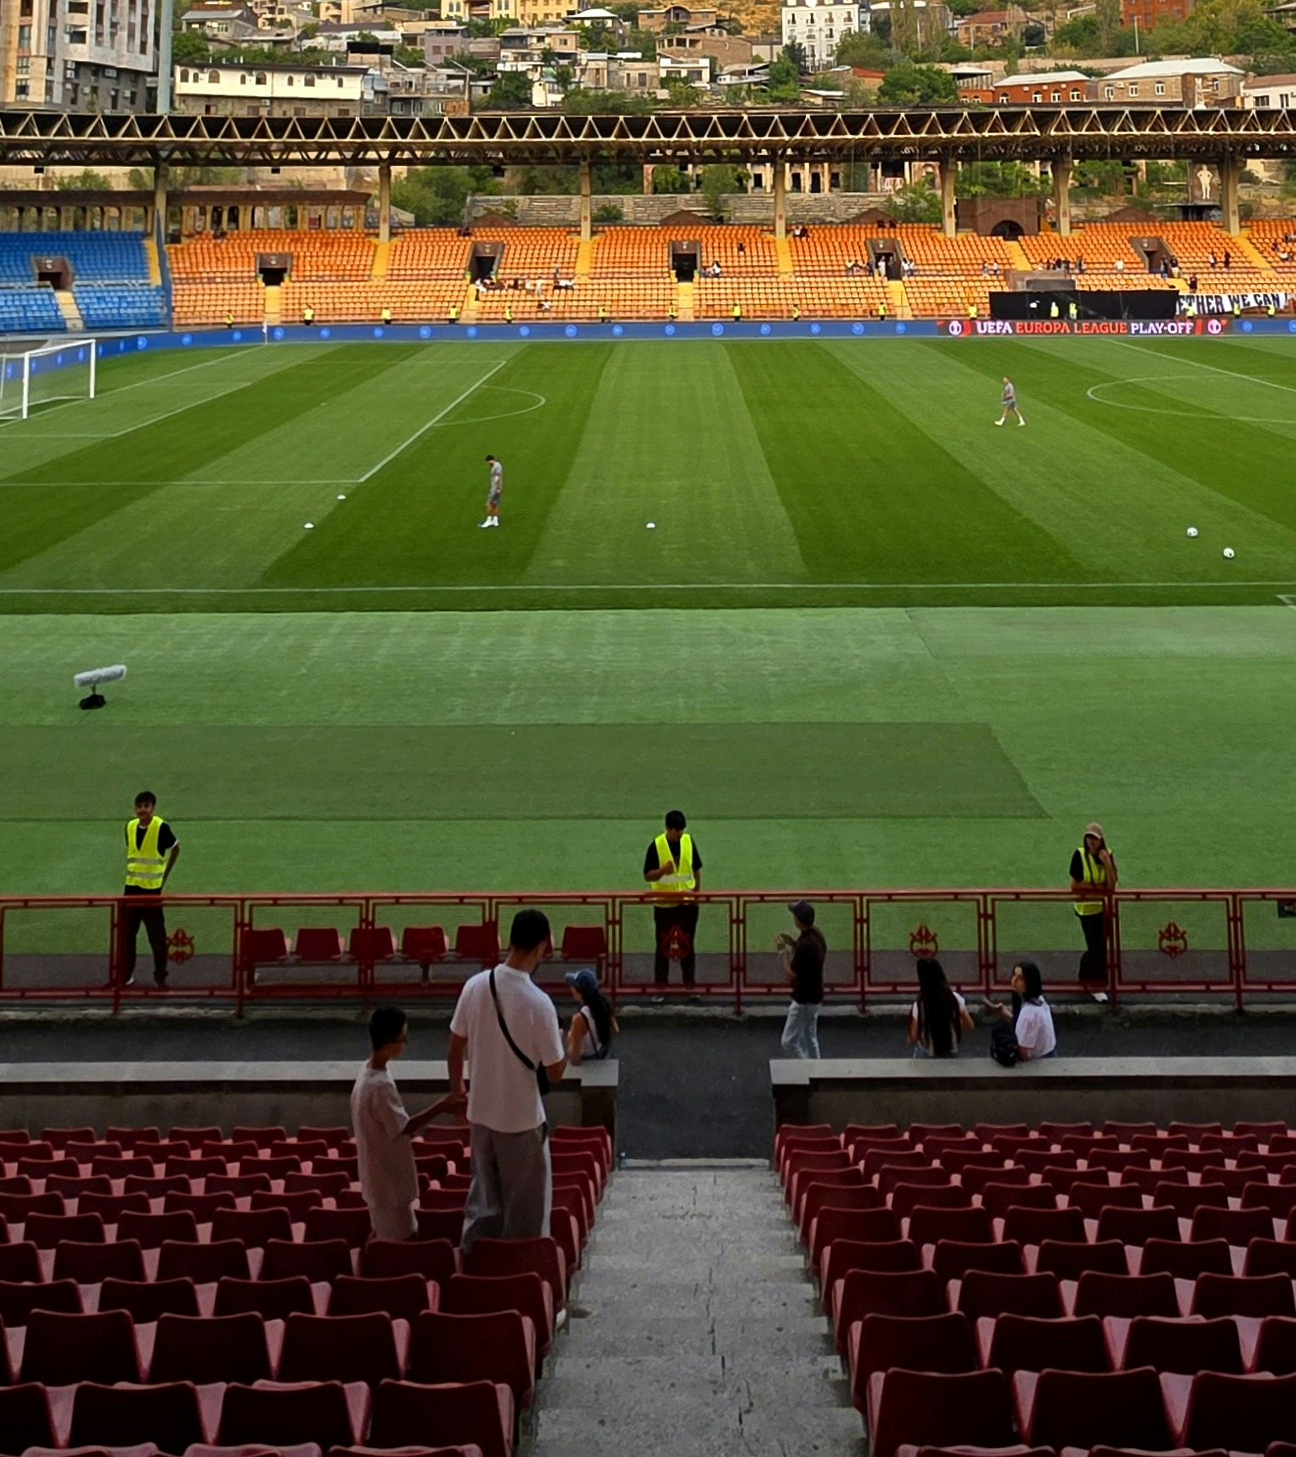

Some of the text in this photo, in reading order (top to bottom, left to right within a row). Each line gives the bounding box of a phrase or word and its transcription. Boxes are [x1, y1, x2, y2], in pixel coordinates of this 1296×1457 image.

[1228, 294, 1251, 309] WE
[1254, 293, 1280, 308] CAN
[976, 321, 1194, 334] UEFA EUROPA LEAGUE PLAY-OFF
